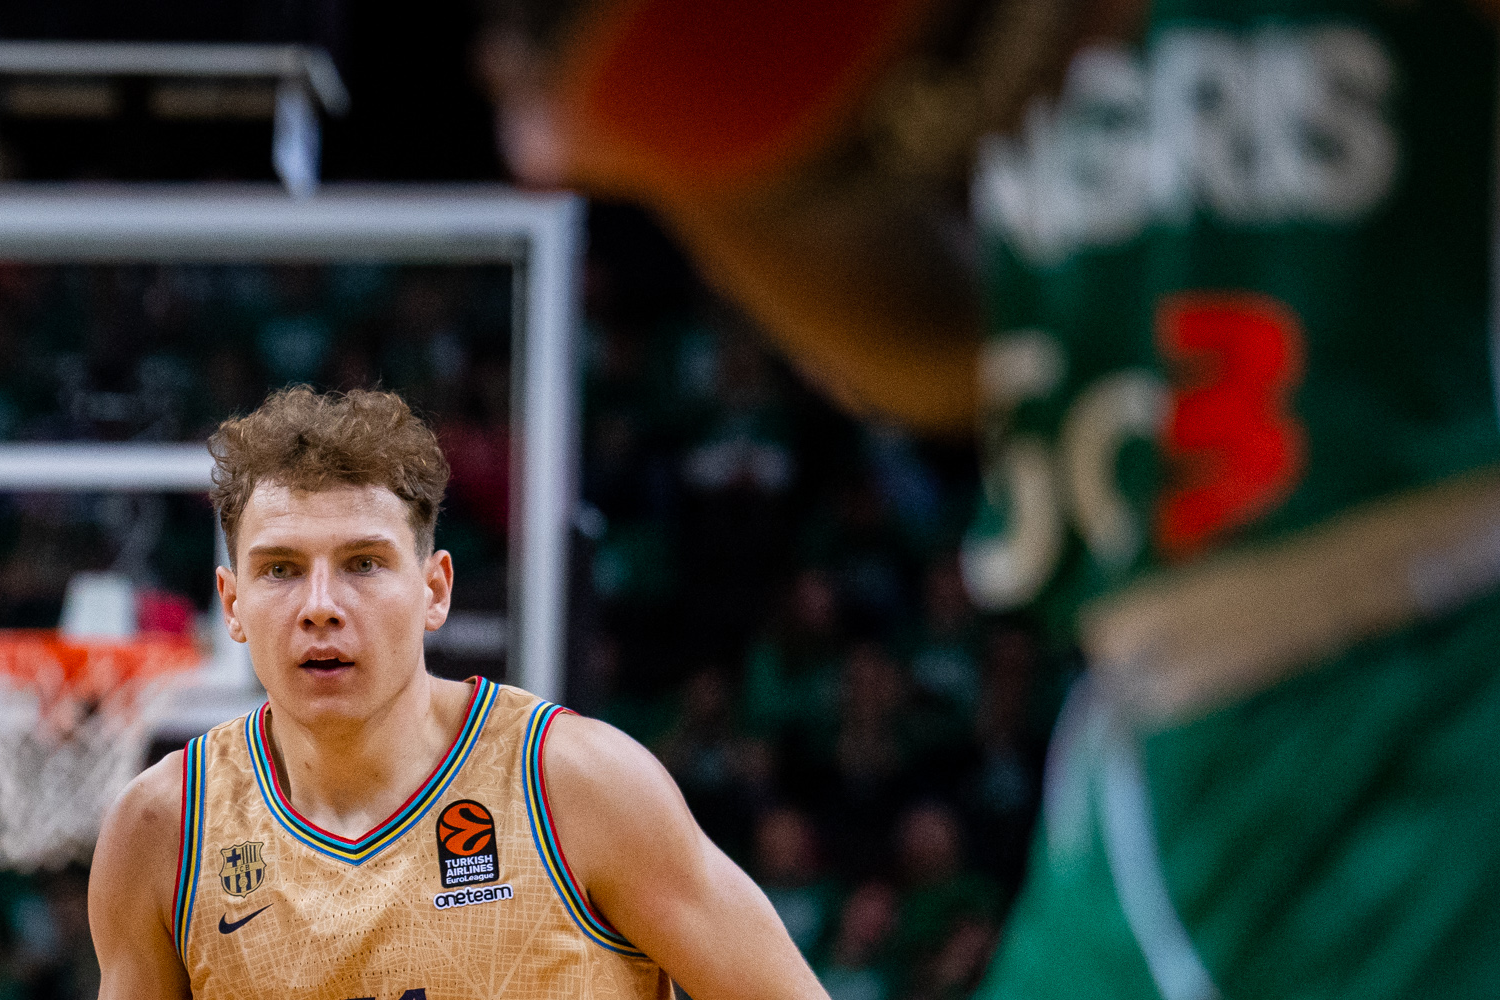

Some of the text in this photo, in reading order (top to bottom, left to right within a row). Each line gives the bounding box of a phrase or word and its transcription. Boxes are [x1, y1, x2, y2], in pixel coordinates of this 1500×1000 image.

[445, 854, 492, 868] TURKISH
[235, 864, 250, 874] FCB
[446, 863, 494, 877] AIRLINES
[446, 873, 494, 884] EuroLeague
[435, 886, 512, 908] oneteam
